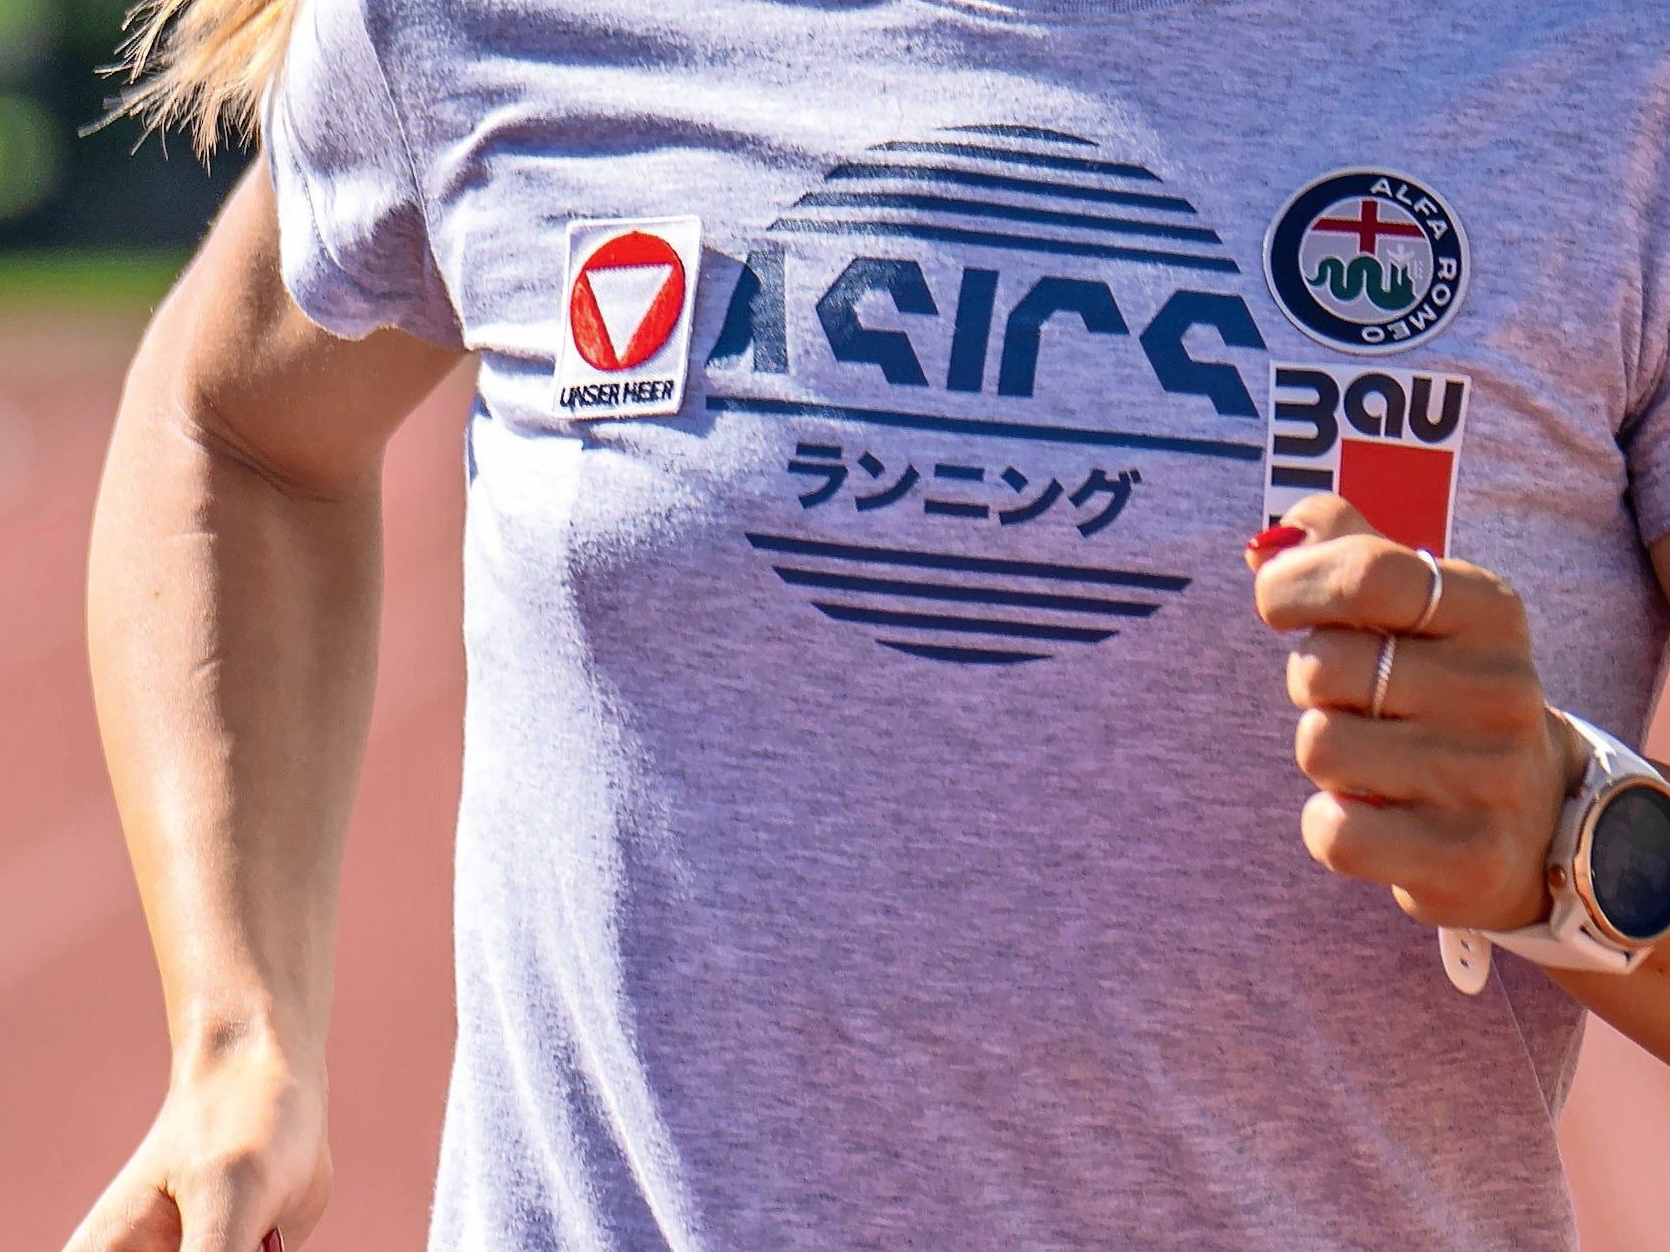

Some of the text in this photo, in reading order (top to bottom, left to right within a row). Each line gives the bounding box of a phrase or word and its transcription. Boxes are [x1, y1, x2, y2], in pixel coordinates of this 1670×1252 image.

[1361, 177, 1458, 345] ALFA ROMEO
[559, 379, 674, 408] UNSER HEER
[787, 443, 1143, 538] ランニング
